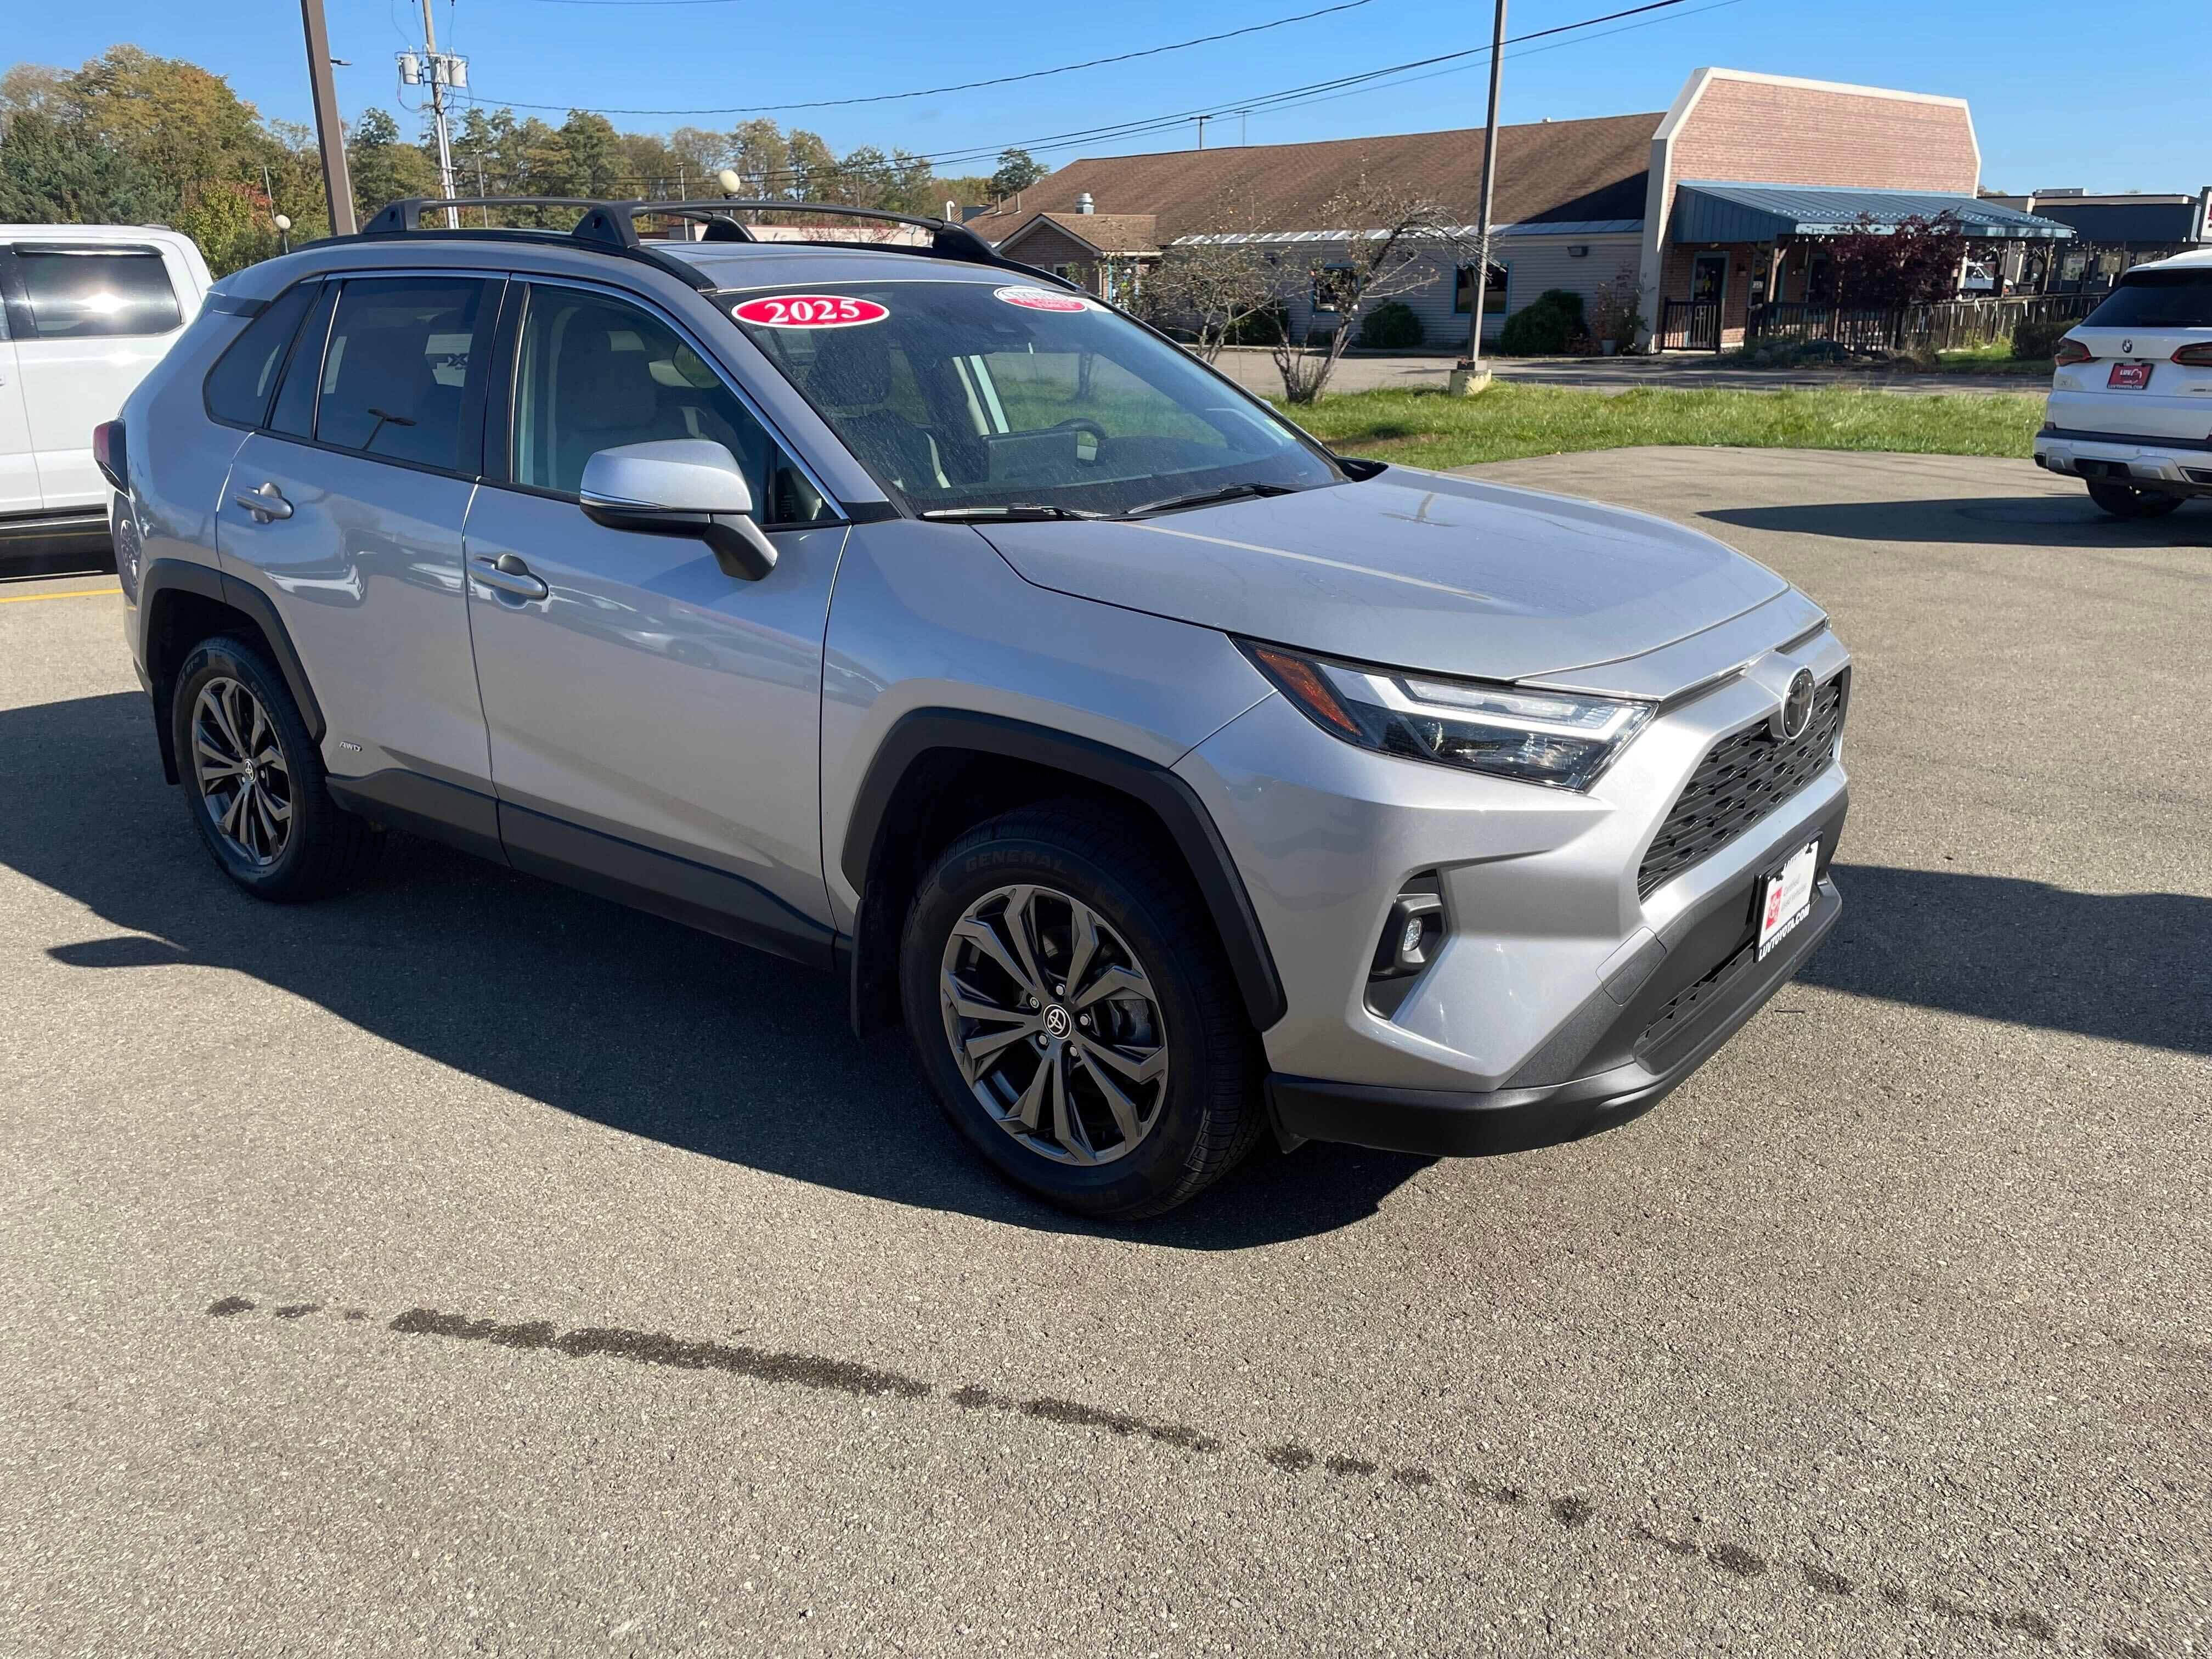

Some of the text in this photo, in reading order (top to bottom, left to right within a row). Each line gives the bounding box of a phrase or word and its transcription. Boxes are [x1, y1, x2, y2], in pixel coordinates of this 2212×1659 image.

[765, 300, 860, 323] 2025
[340, 741, 362, 752] AWD
[964, 849, 1067, 873] GENERAL
[1758, 904, 1810, 962] LUVTOYOTA.COM
